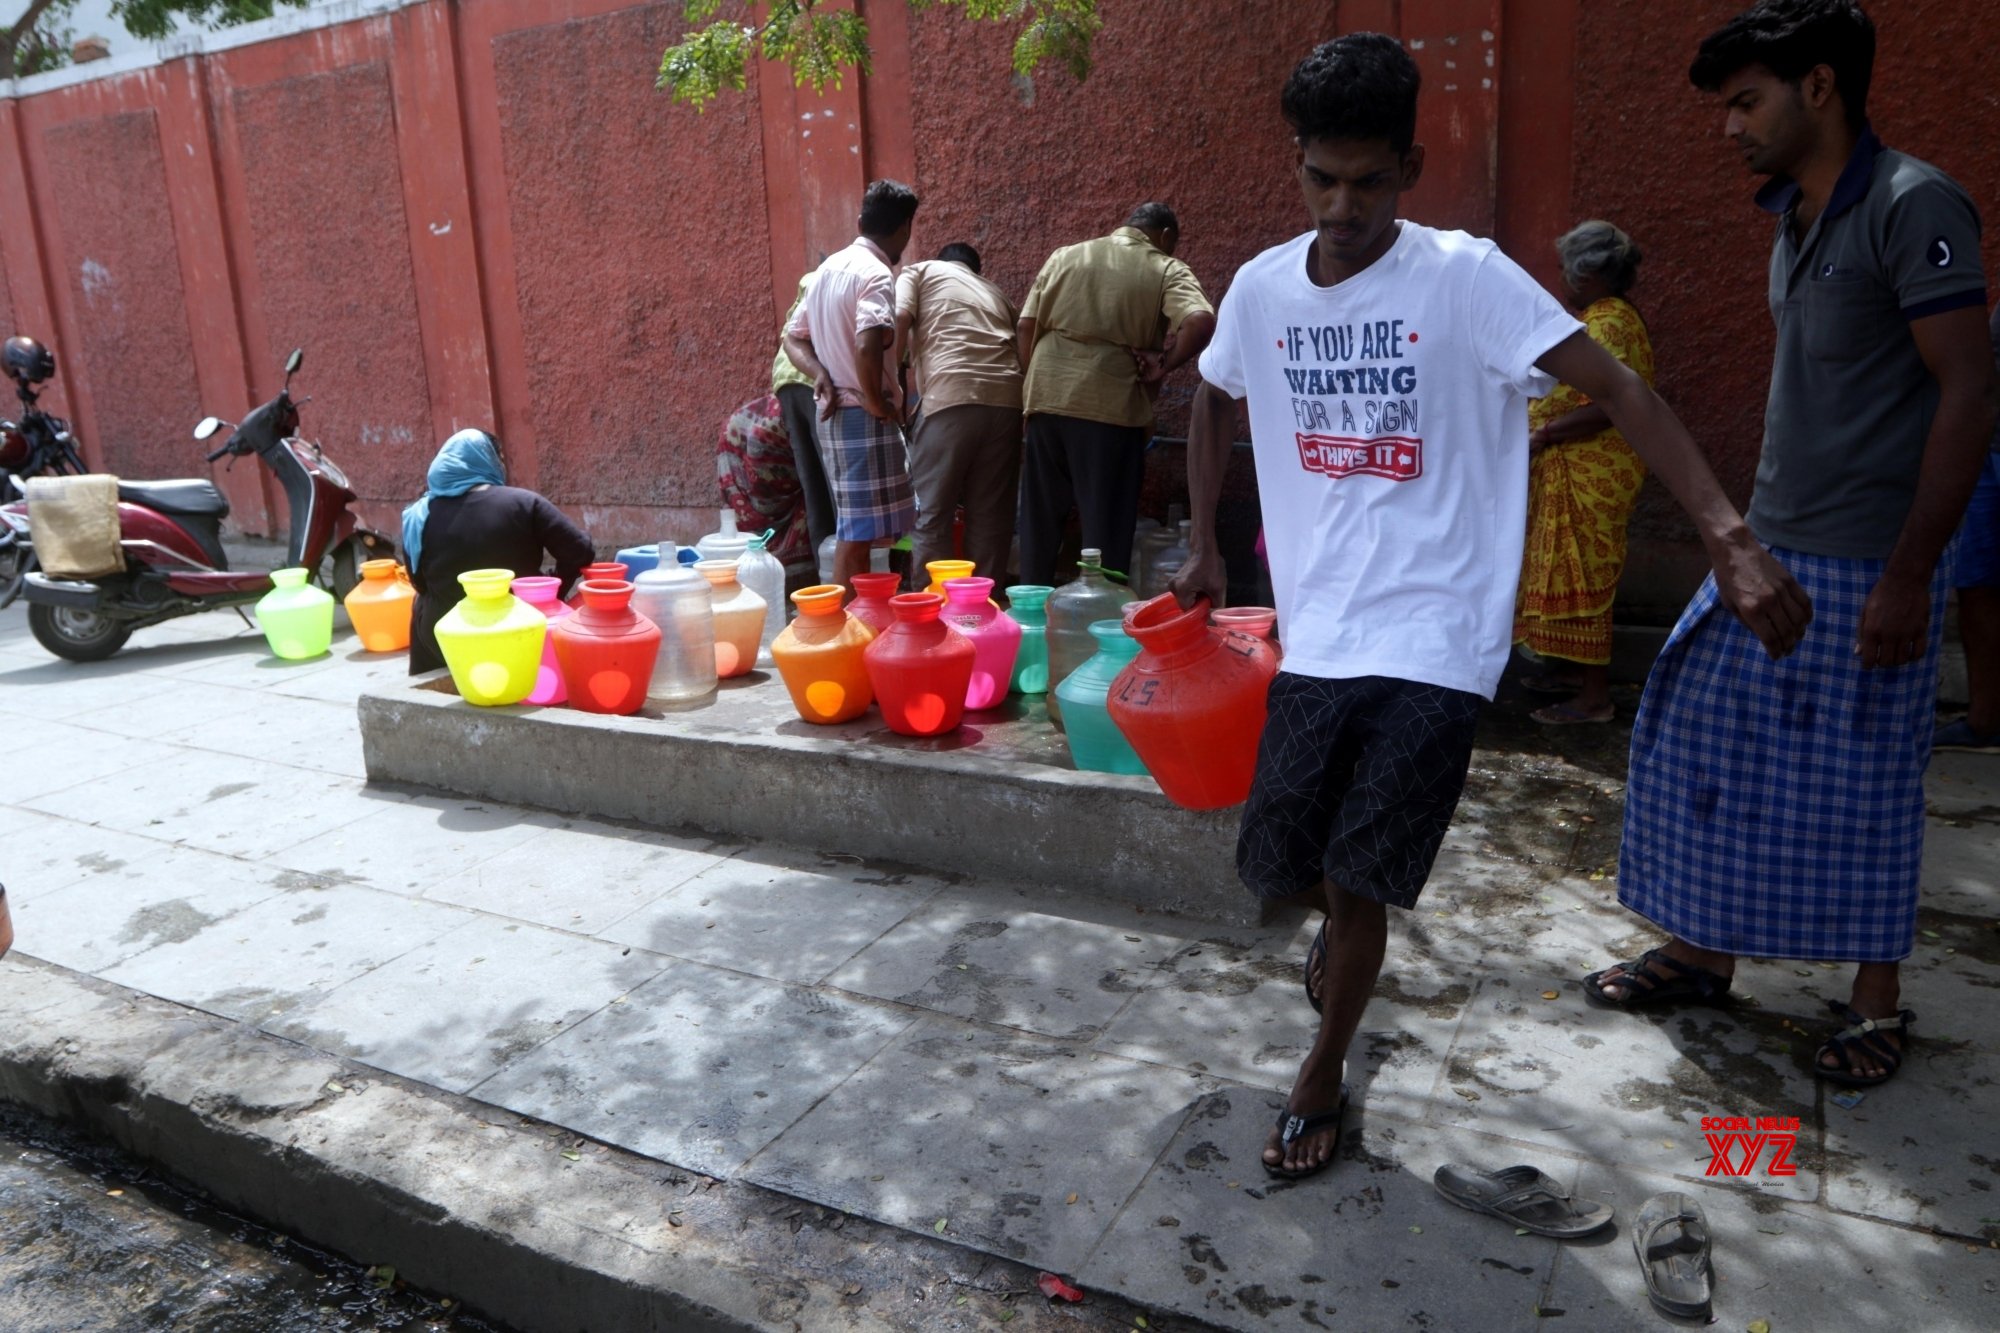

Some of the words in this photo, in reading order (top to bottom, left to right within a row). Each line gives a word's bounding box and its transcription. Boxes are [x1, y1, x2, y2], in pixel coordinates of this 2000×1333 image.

[1287, 326, 1304, 361] IF
[1308, 325, 1354, 361] YOU
[1360, 320, 1403, 360] ARE
[1284, 366, 1417, 395] WAITING
[1292, 398, 1331, 430] FOR
[1342, 400, 1356, 432] A
[1365, 400, 1418, 434] SIGN
[1376, 446, 1396, 466] IT
